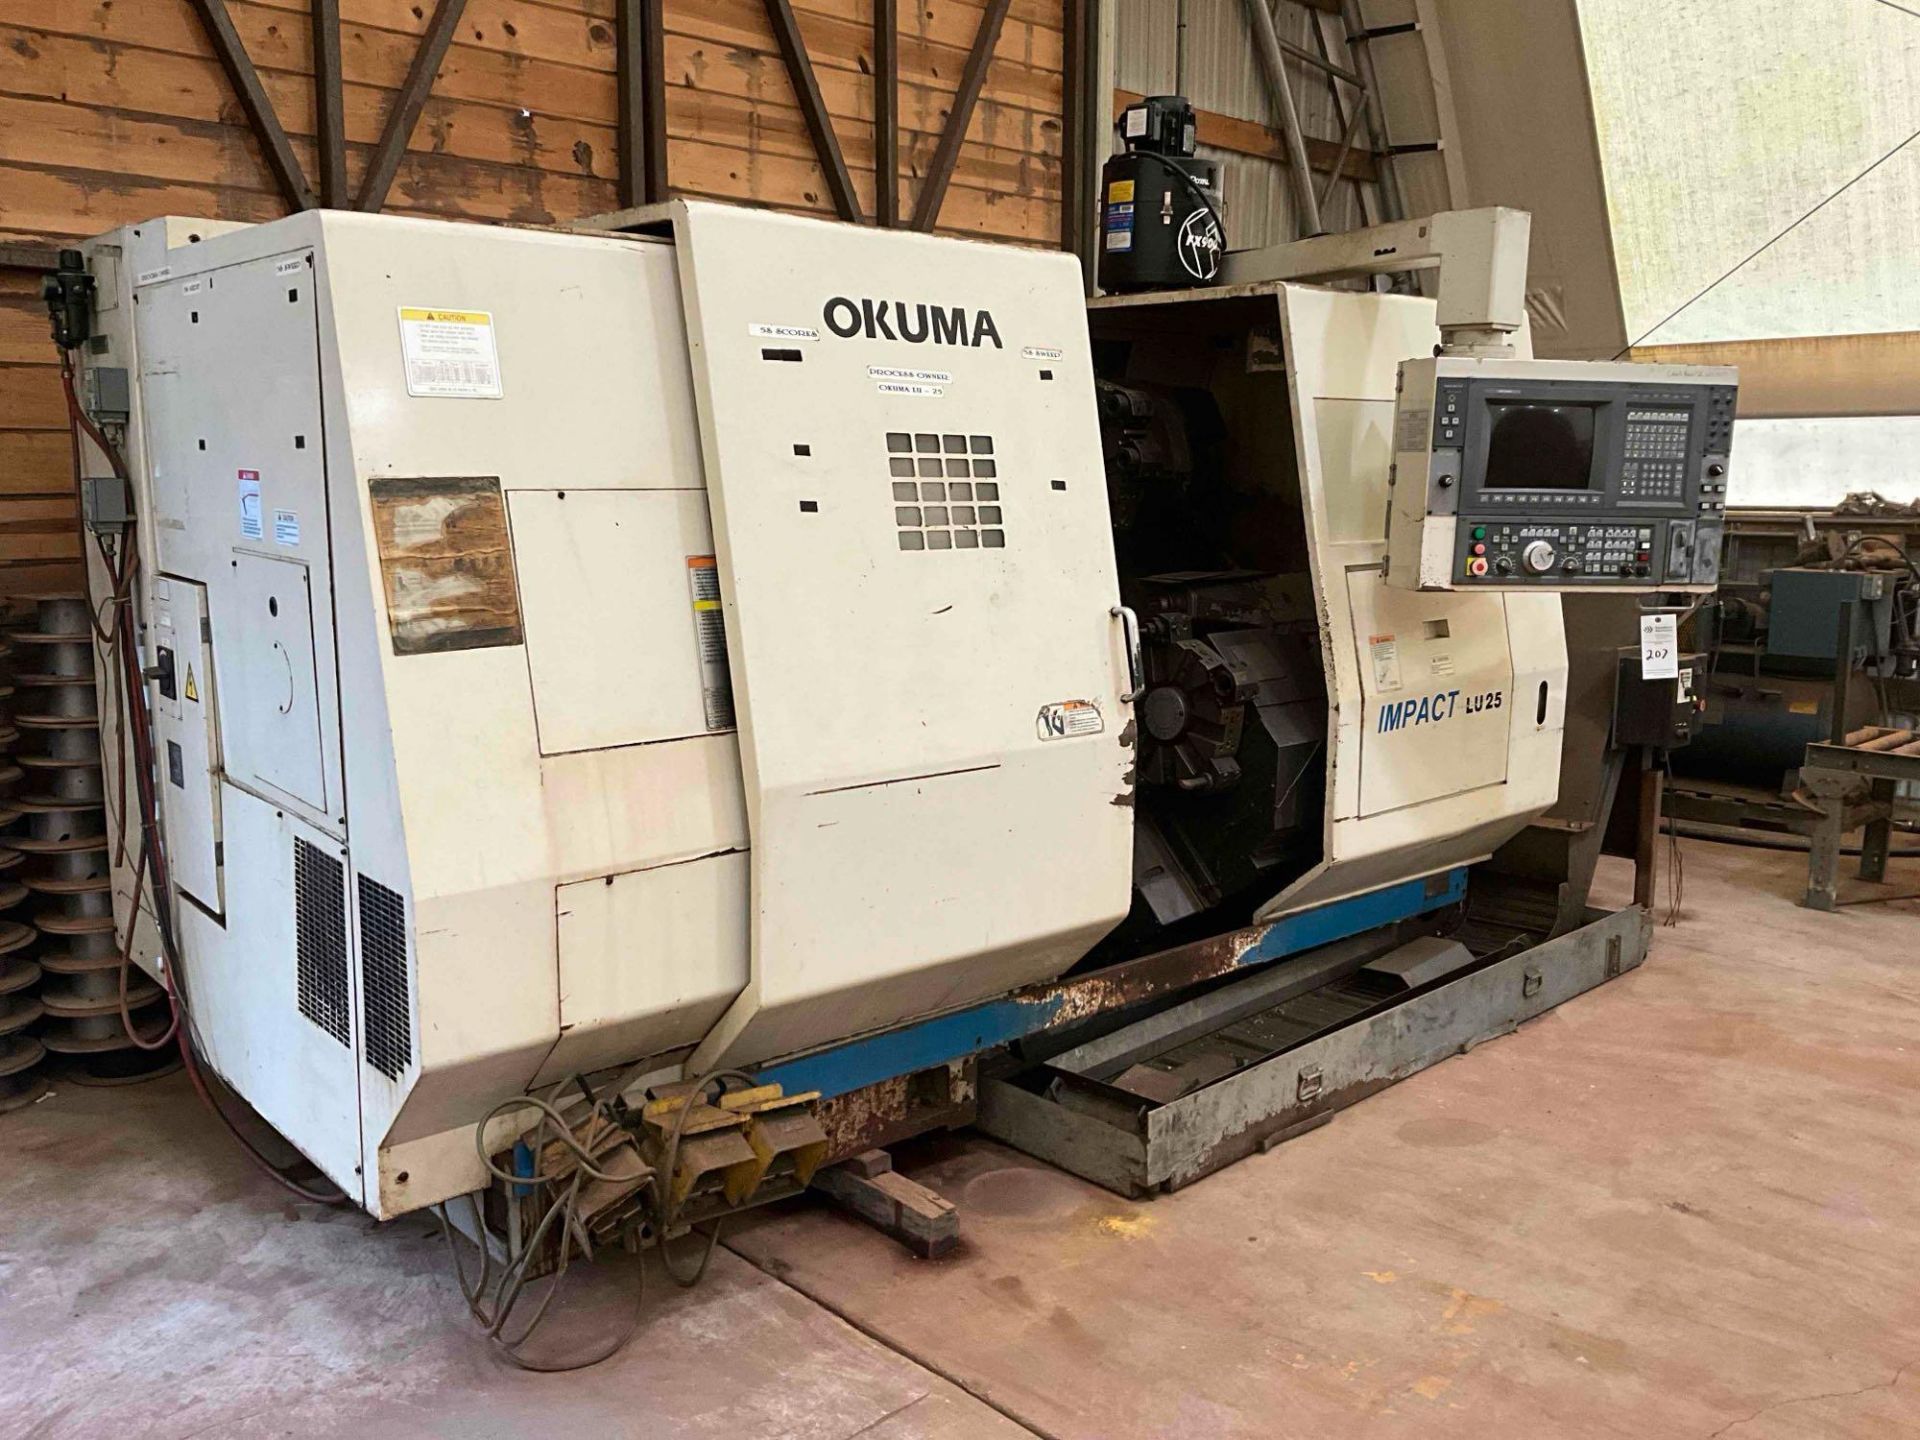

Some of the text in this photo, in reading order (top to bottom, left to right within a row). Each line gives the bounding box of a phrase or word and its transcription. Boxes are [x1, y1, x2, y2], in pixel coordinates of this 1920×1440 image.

[438, 312, 466, 322] CAUTION
[823, 296, 1003, 349] OKUMA
[775, 328, 818, 337] SCORES
[869, 368, 949, 381] PROCESS OWNER
[878, 384, 910, 393] OKUMA
[1645, 648, 1669, 661] 207
[1378, 690, 1460, 733] IMPACT
